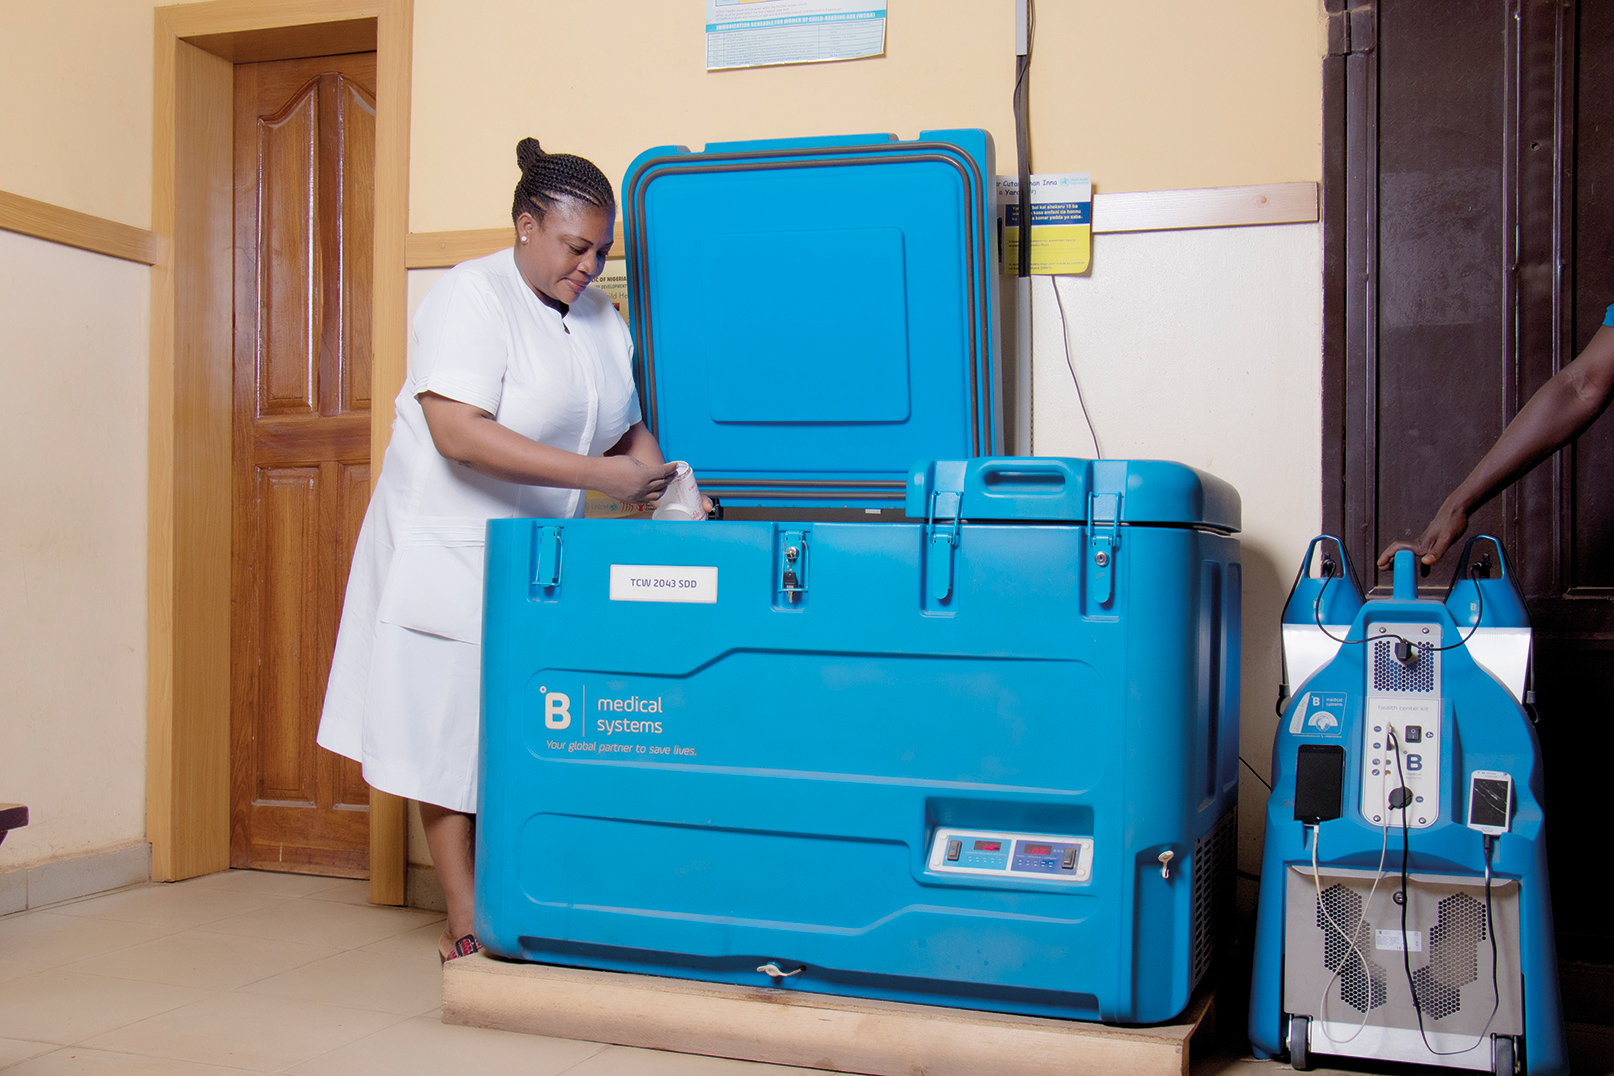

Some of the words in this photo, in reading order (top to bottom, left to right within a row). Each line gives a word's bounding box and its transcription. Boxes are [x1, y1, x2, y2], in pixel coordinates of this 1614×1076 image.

[715, 22, 750, 31] IMMUNIZATION
[750, 20, 774, 28] SCHEDULE
[630, 578, 651, 587] TCW
[653, 578, 676, 588] 2043
[679, 579, 697, 589] SDD
[597, 696, 663, 713] medical
[597, 718, 663, 736] systems
[546, 740, 566, 750] Your
[568, 740, 597, 753] global
[598, 743, 633, 754] partner
[635, 743, 646, 754] to
[649, 745, 671, 755] save
[673, 745, 697, 756] lives.
